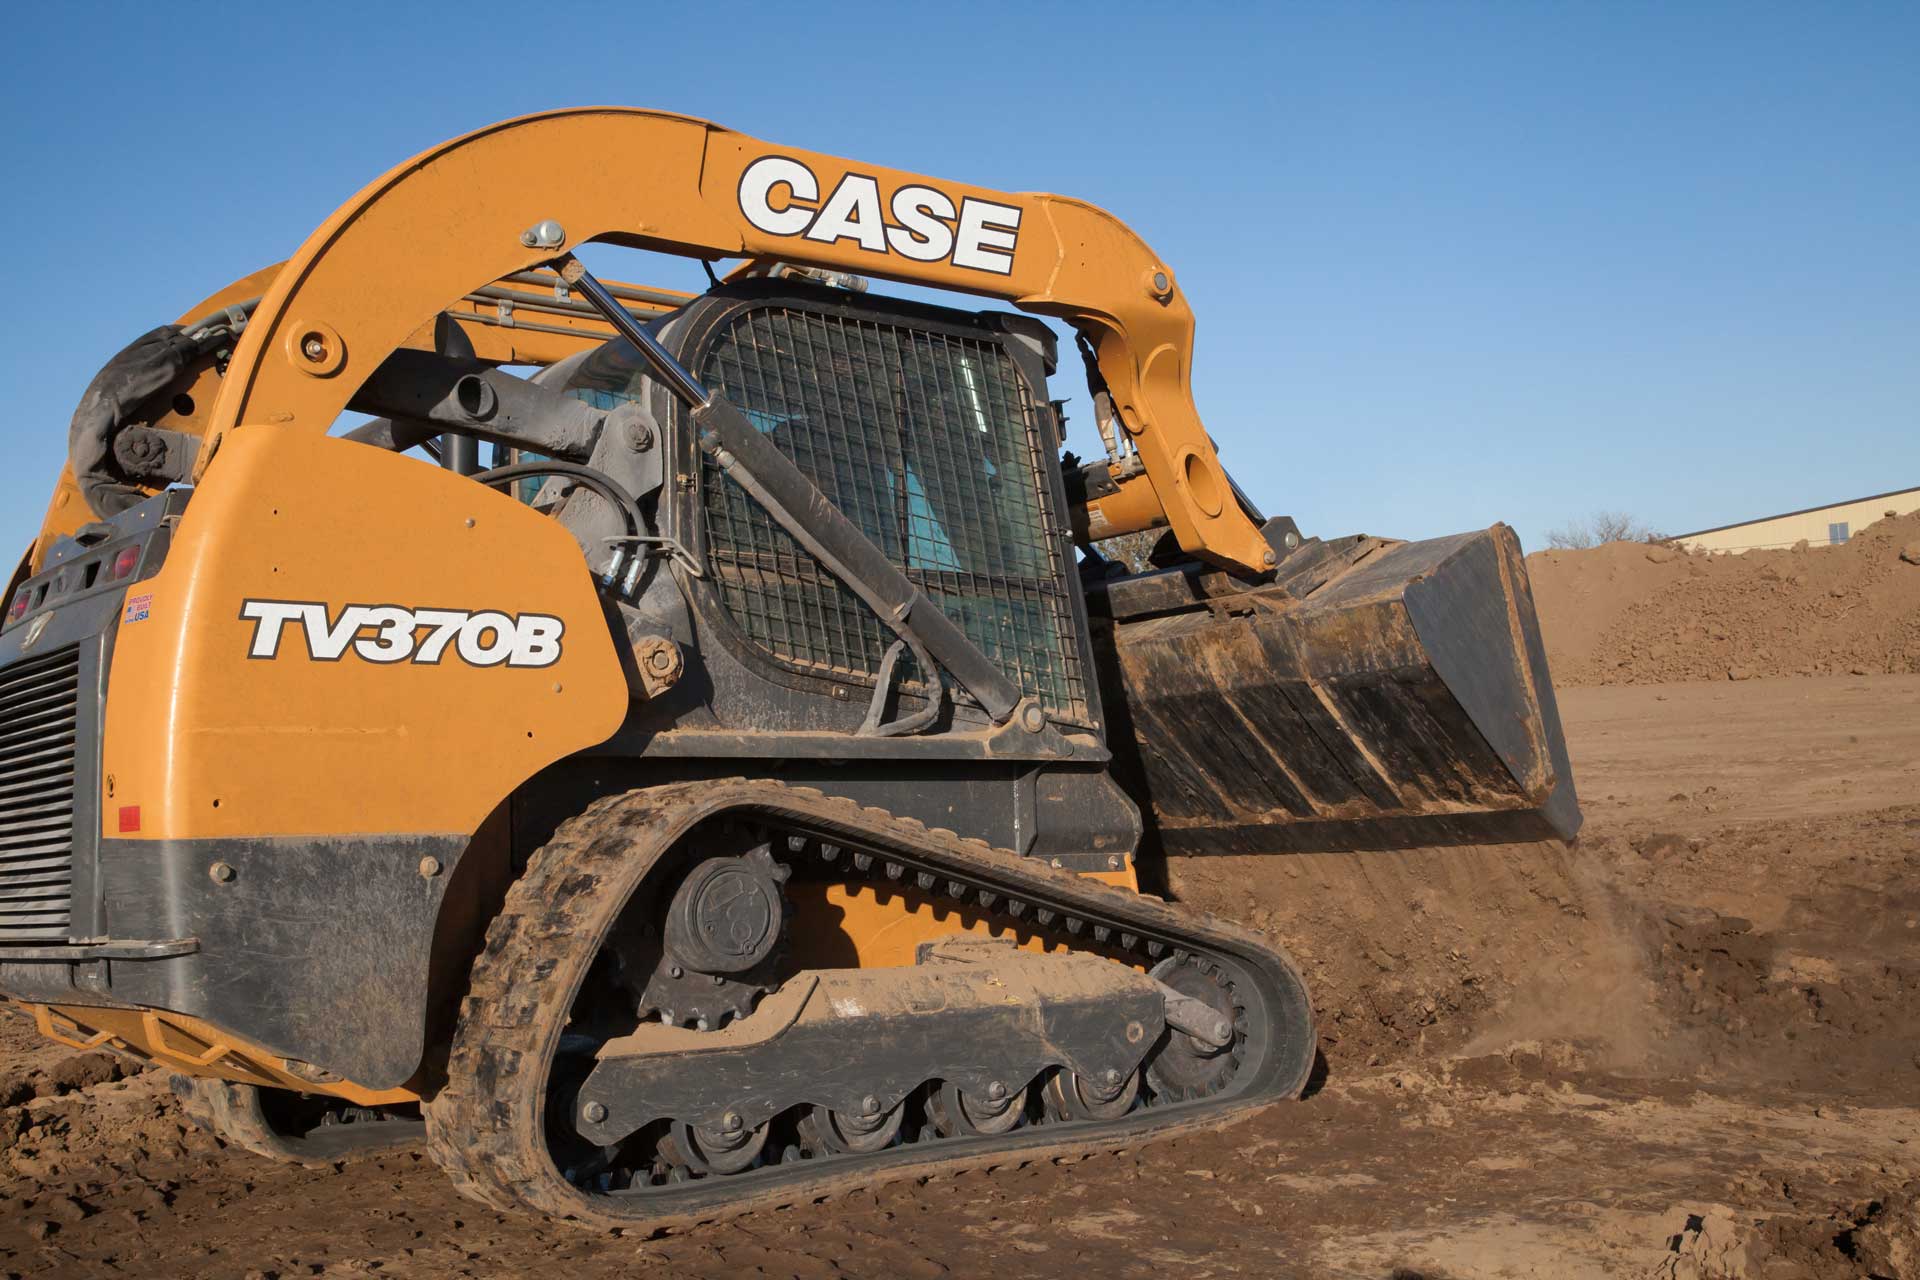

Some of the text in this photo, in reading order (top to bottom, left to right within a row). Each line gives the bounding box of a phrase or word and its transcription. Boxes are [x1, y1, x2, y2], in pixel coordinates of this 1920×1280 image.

[737, 154, 1023, 276] CASE
[135, 610, 149, 621] USA
[238, 598, 566, 668] TV370B
